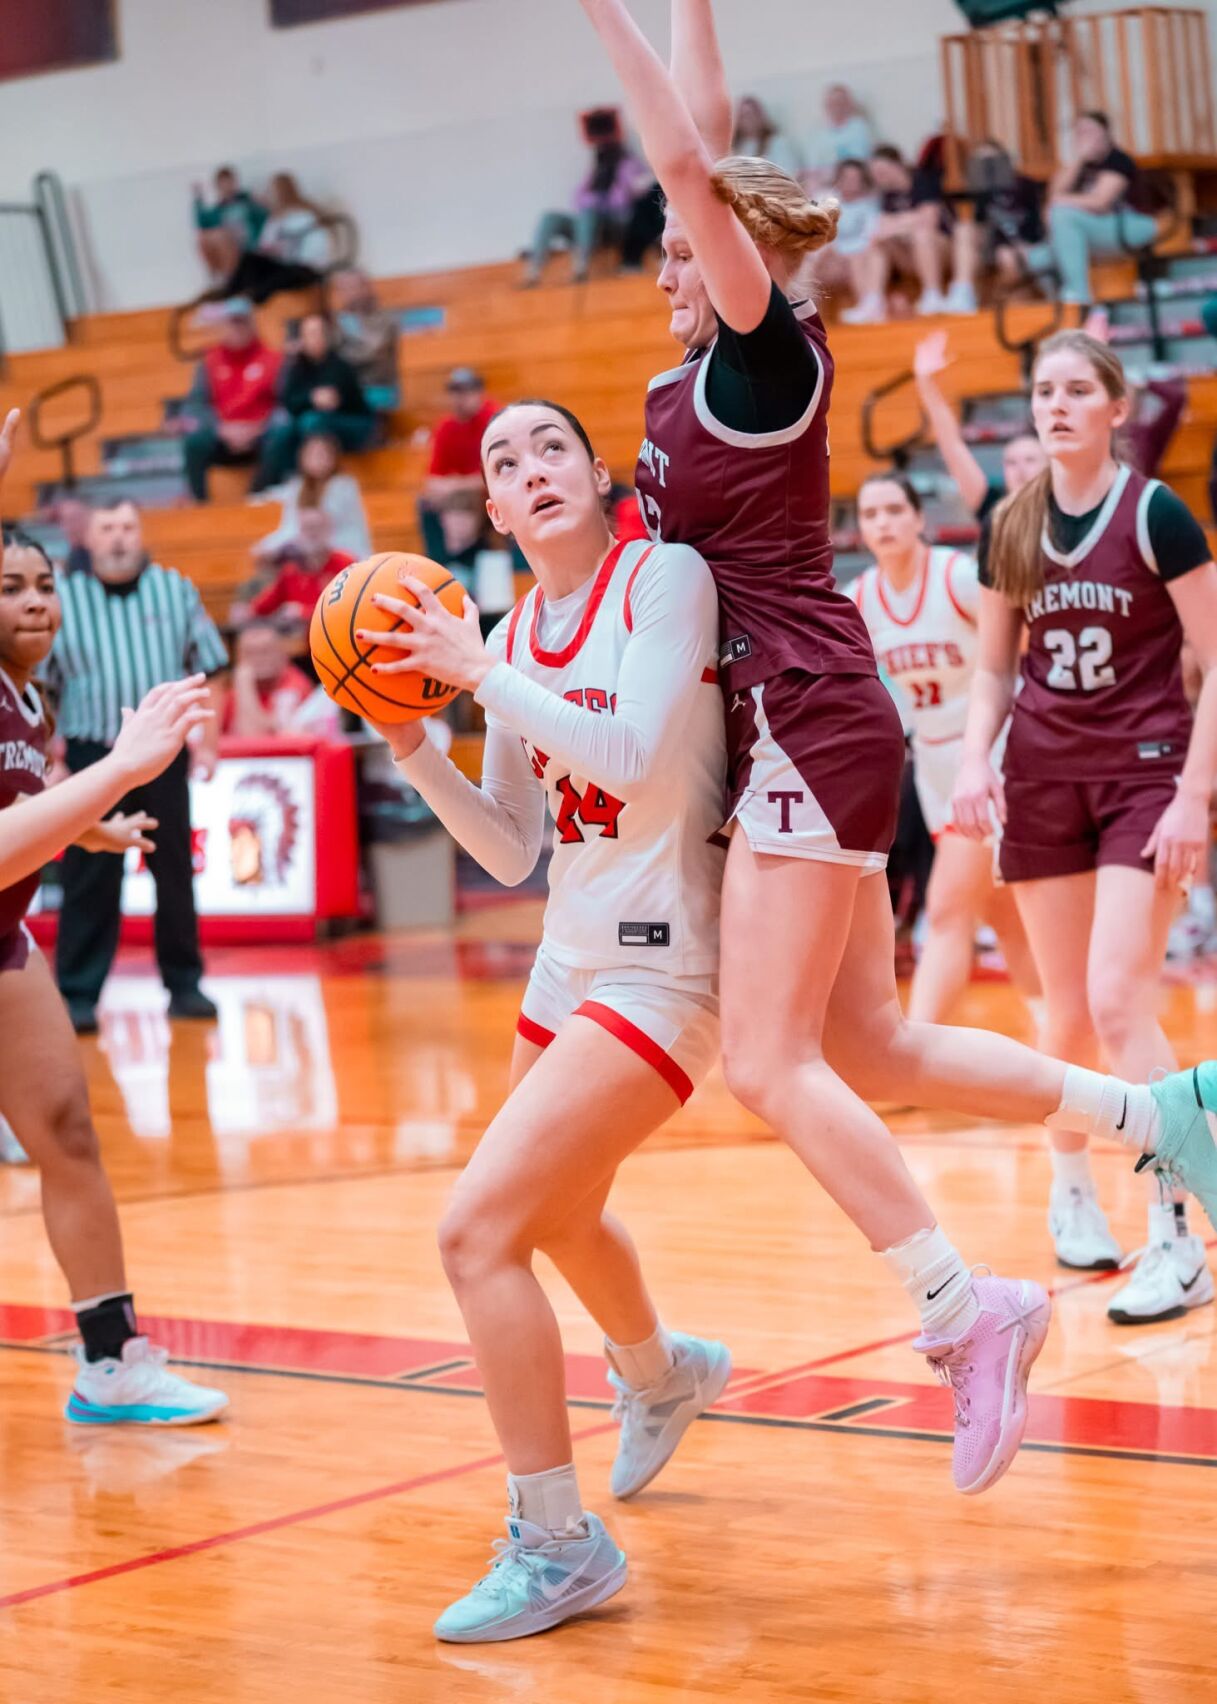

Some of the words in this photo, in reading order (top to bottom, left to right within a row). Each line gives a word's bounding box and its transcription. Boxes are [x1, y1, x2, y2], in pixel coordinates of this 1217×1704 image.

[736, 641, 746, 654] M
[880, 640, 966, 678] HIEFS
[1043, 625, 1117, 691] 22
[555, 773, 628, 844] 14
[767, 790, 804, 834] T
[653, 929, 663, 940] M
